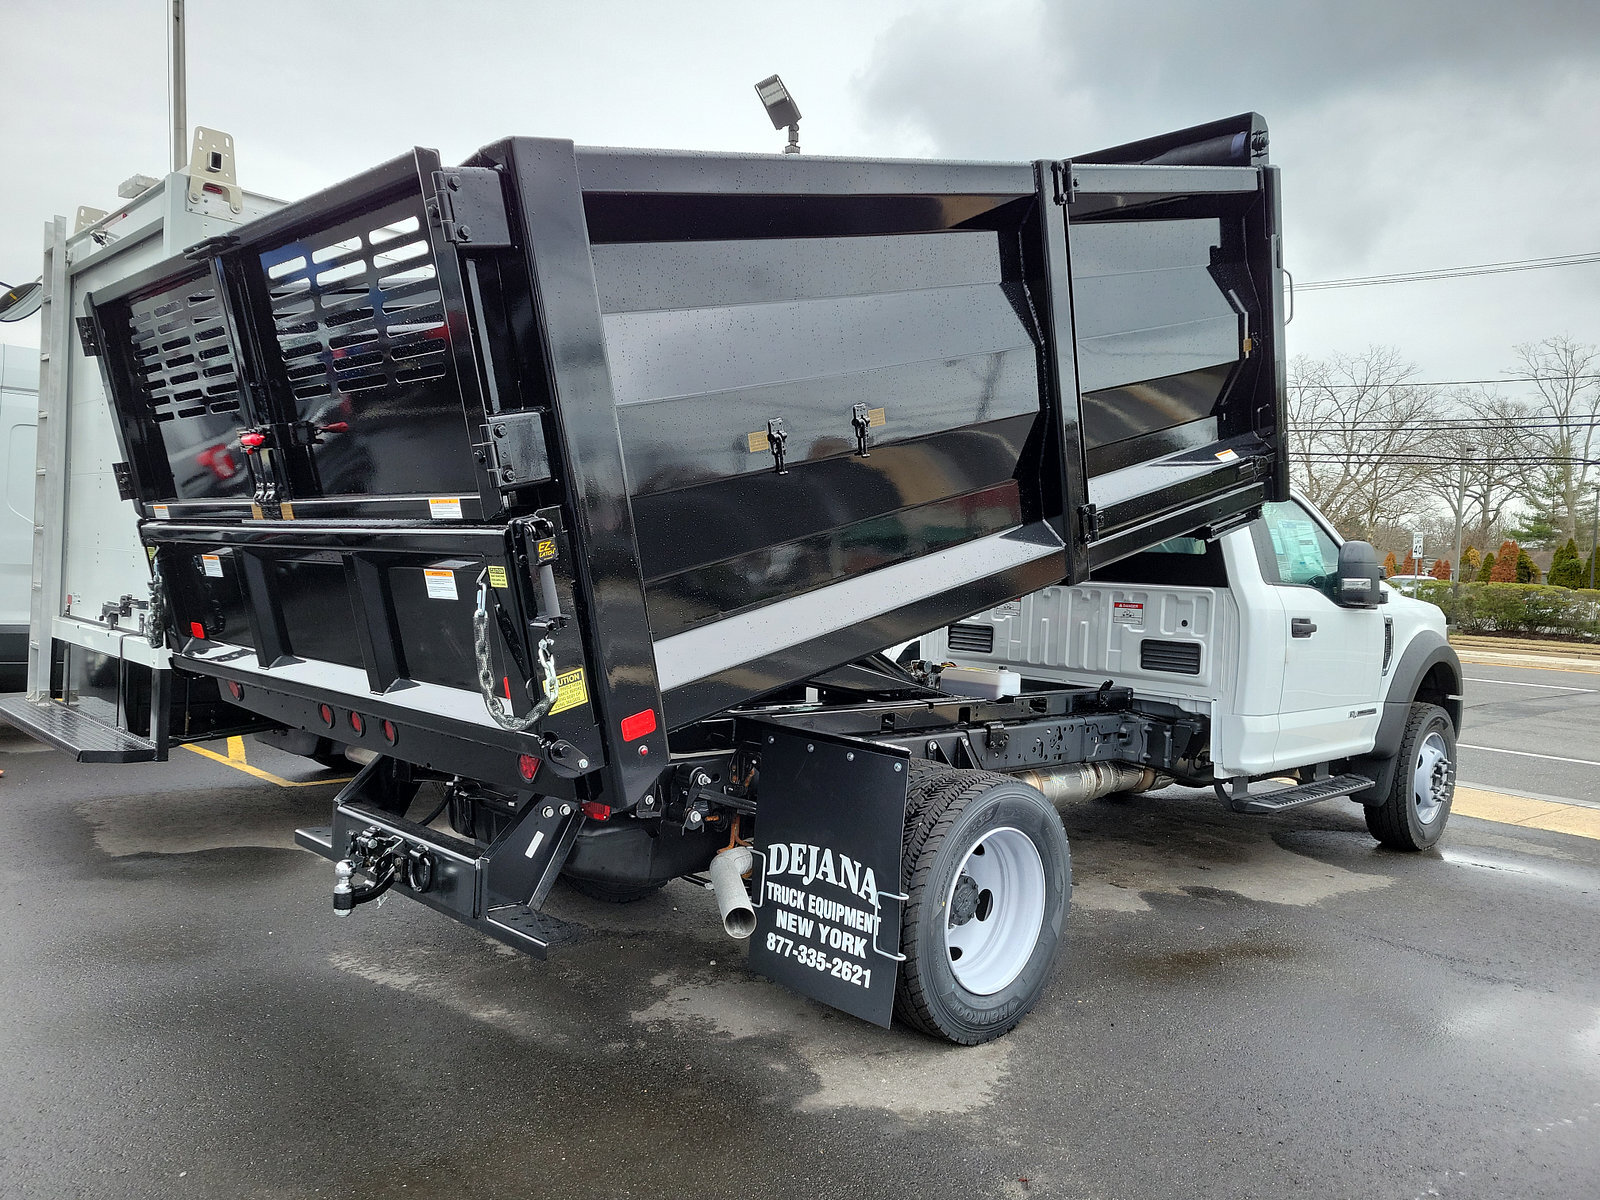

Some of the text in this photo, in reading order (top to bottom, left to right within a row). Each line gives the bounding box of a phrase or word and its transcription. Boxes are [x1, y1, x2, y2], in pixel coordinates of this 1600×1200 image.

[1413, 545, 1422, 554] 40
[767, 843, 881, 909] DEJANA
[766, 881, 881, 936] TRUCK EQUIPMENT
[776, 909, 868, 959] NEW YORK
[767, 932, 871, 989] 877-335-2621
